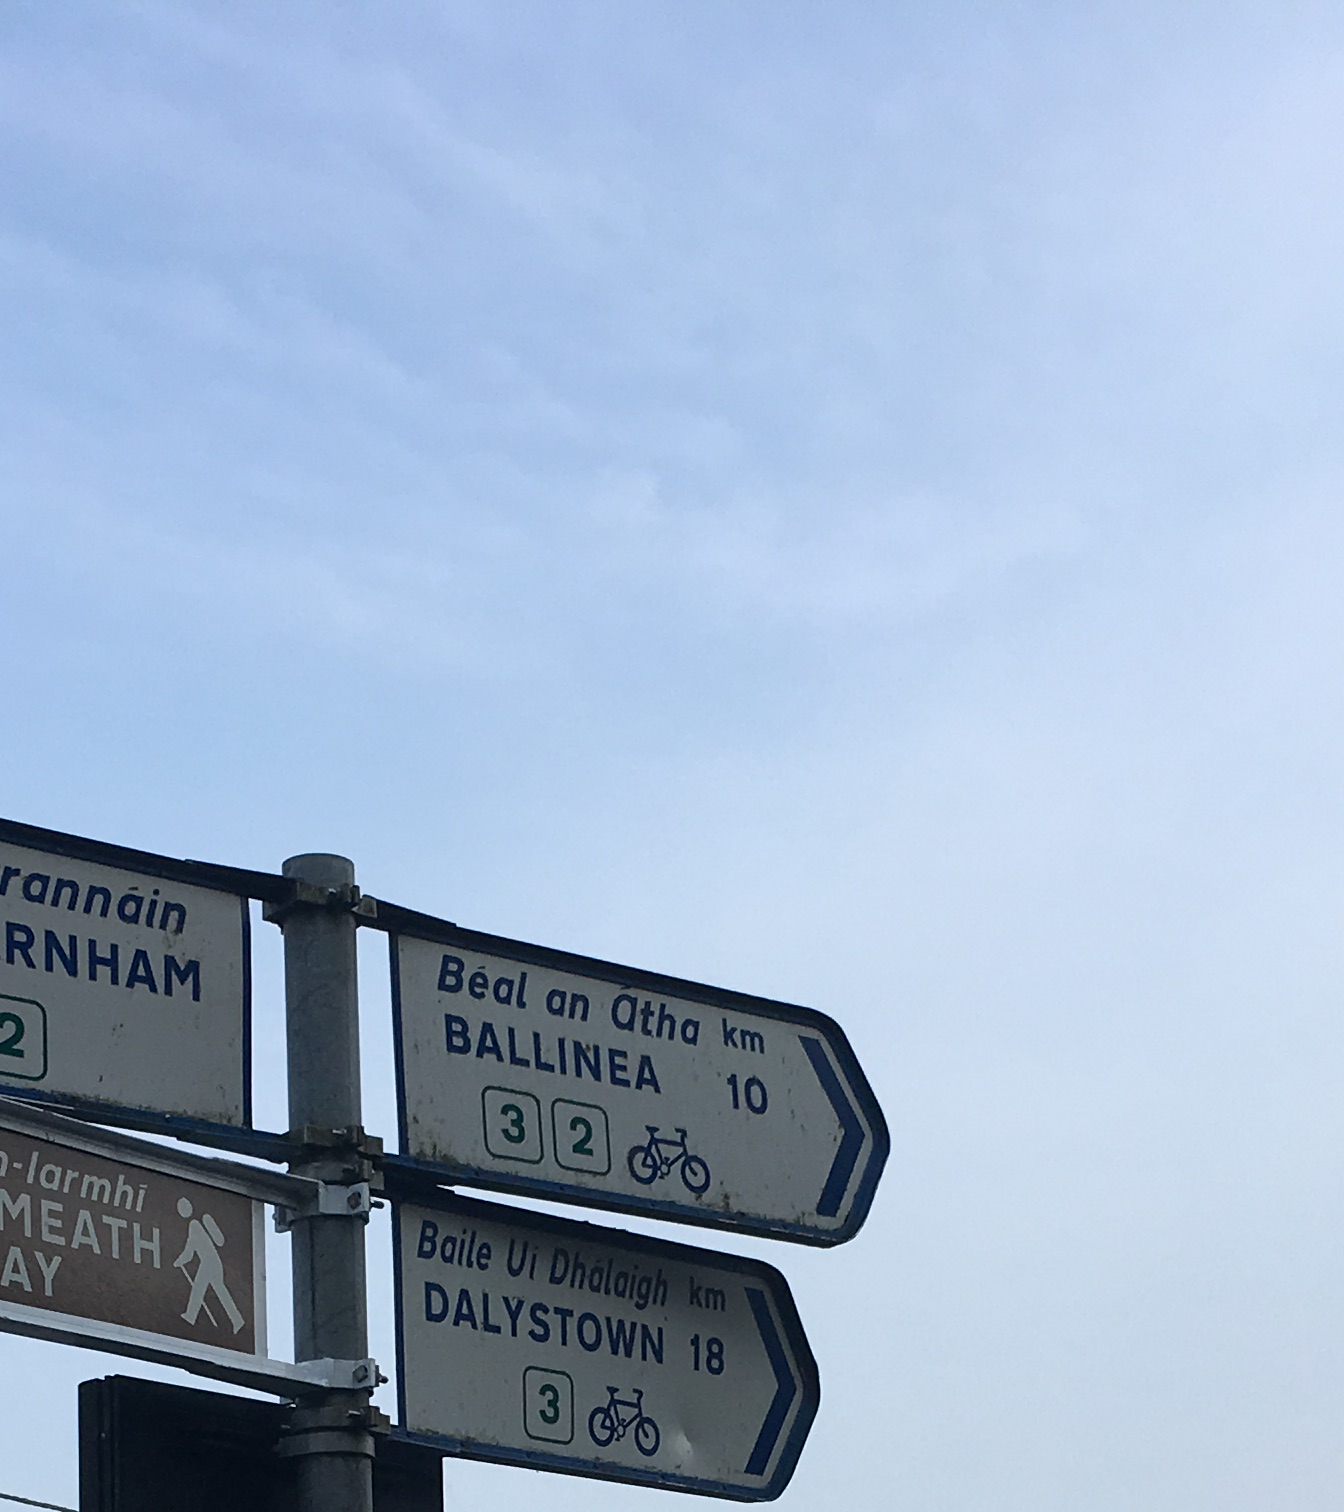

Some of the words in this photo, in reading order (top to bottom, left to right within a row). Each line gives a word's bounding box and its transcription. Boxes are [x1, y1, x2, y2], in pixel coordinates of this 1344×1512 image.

[437, 954, 527, 1009] Béal
[546, 988, 590, 1022] an
[721, 1017, 766, 1054] km
[444, 1013, 661, 1094] BALLINEA
[726, 1073, 768, 1115] 10
[500, 1103, 526, 1144] 3
[569, 1116, 593, 1157] 2
[416, 1219, 492, 1271] Baile
[549, 1247, 668, 1311] Dhálaigh
[689, 1276, 726, 1311] km
[424, 1281, 664, 1364] DALYSTOWN
[690, 1333, 725, 1376] 18
[538, 1383, 560, 1425] 3
